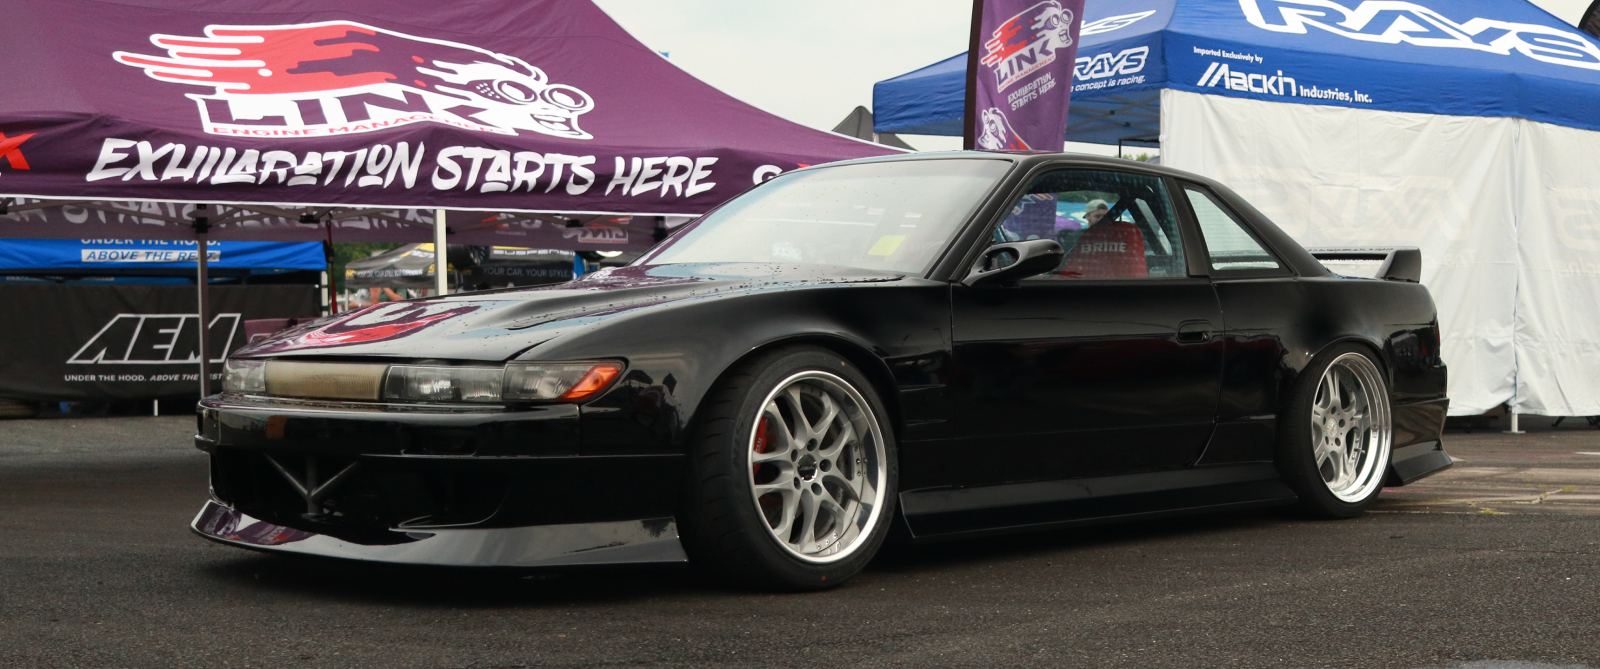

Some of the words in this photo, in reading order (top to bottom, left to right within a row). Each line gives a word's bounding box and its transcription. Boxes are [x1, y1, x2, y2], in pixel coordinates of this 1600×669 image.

[1238, 0, 1600, 70] RAYS
[996, 39, 1054, 88] LINK
[1015, 55, 1055, 79] MANAGEMENT
[1073, 46, 1149, 81] RAYS
[1193, 46, 1221, 57] Imported
[1222, 50, 1254, 63] Exclusively
[1254, 54, 1264, 64] by
[1007, 72, 1053, 104] EXHILARATION
[1011, 90, 1038, 111] STARTS
[1039, 78, 1056, 95] HERE
[1075, 81, 1107, 92] concept
[1108, 79, 1116, 87] is
[1117, 75, 1146, 85] racing.
[1196, 62, 1297, 97] Mackin
[1300, 85, 1353, 103] Industries,
[1354, 90, 1373, 103] Inc.
[197, 88, 510, 131] LINK
[212, 127, 320, 137] ENGINE
[86, 138, 425, 189] EXHILARATION
[432, 145, 596, 196] STARTS
[605, 156, 719, 199] HERE
[87, 250, 140, 261] ABOVE
[145, 250, 173, 261] THE
[178, 251, 217, 261] RET.
[1080, 242, 1127, 253] BRIDE
[483, 266, 505, 275] YOUR
[506, 267, 524, 276] CAR.
[526, 269, 547, 277] YOUR
[548, 269, 571, 278] STYLE.
[66, 313, 241, 364] AEM
[64, 374, 96, 382] UNDER
[98, 374, 116, 382] THE
[118, 374, 147, 382] HOOD.
[150, 373, 180, 382] ABOVE
[182, 373, 199, 381] THE
